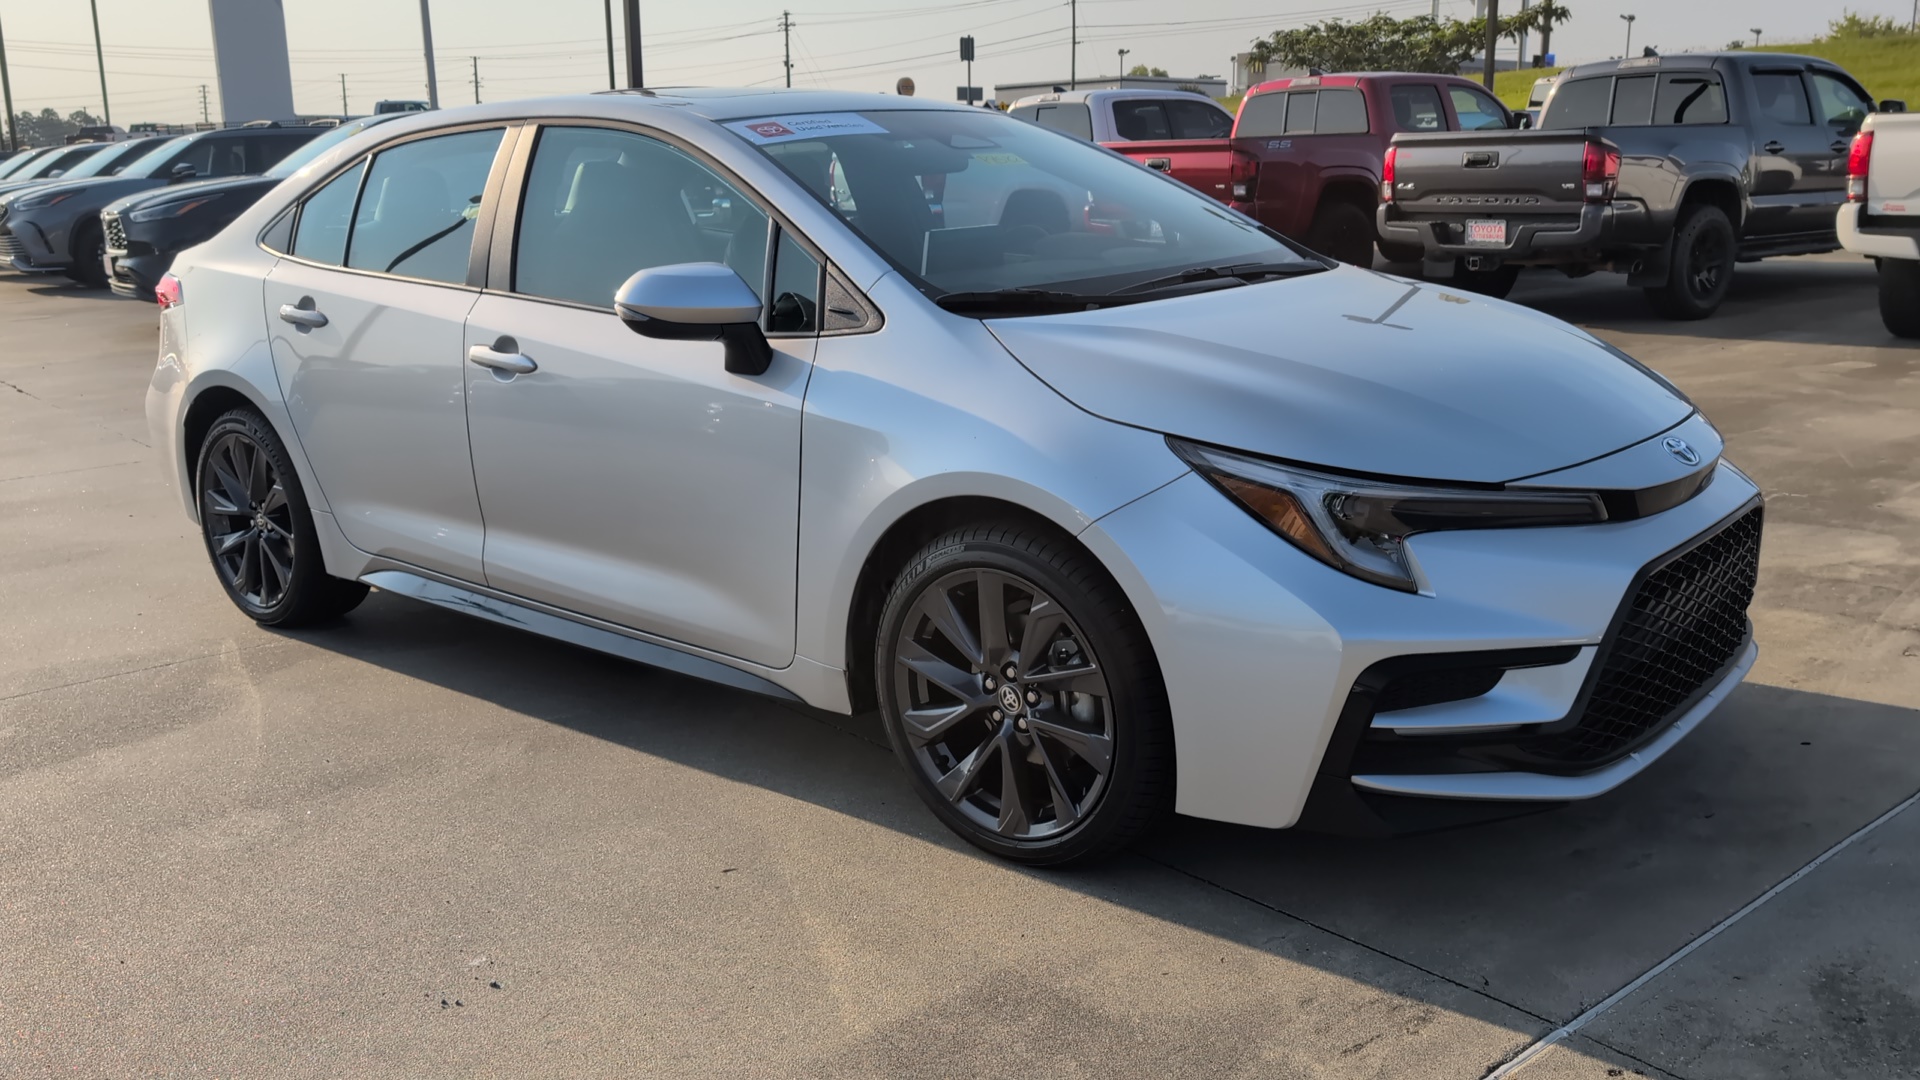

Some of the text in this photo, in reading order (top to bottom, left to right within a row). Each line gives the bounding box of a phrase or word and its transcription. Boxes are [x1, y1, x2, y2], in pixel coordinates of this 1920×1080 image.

[787, 119, 832, 127] Certified
[796, 124, 823, 132] Used
[1433, 196, 1540, 206] TACOMA
[1469, 225, 1503, 233] TOYOTA
